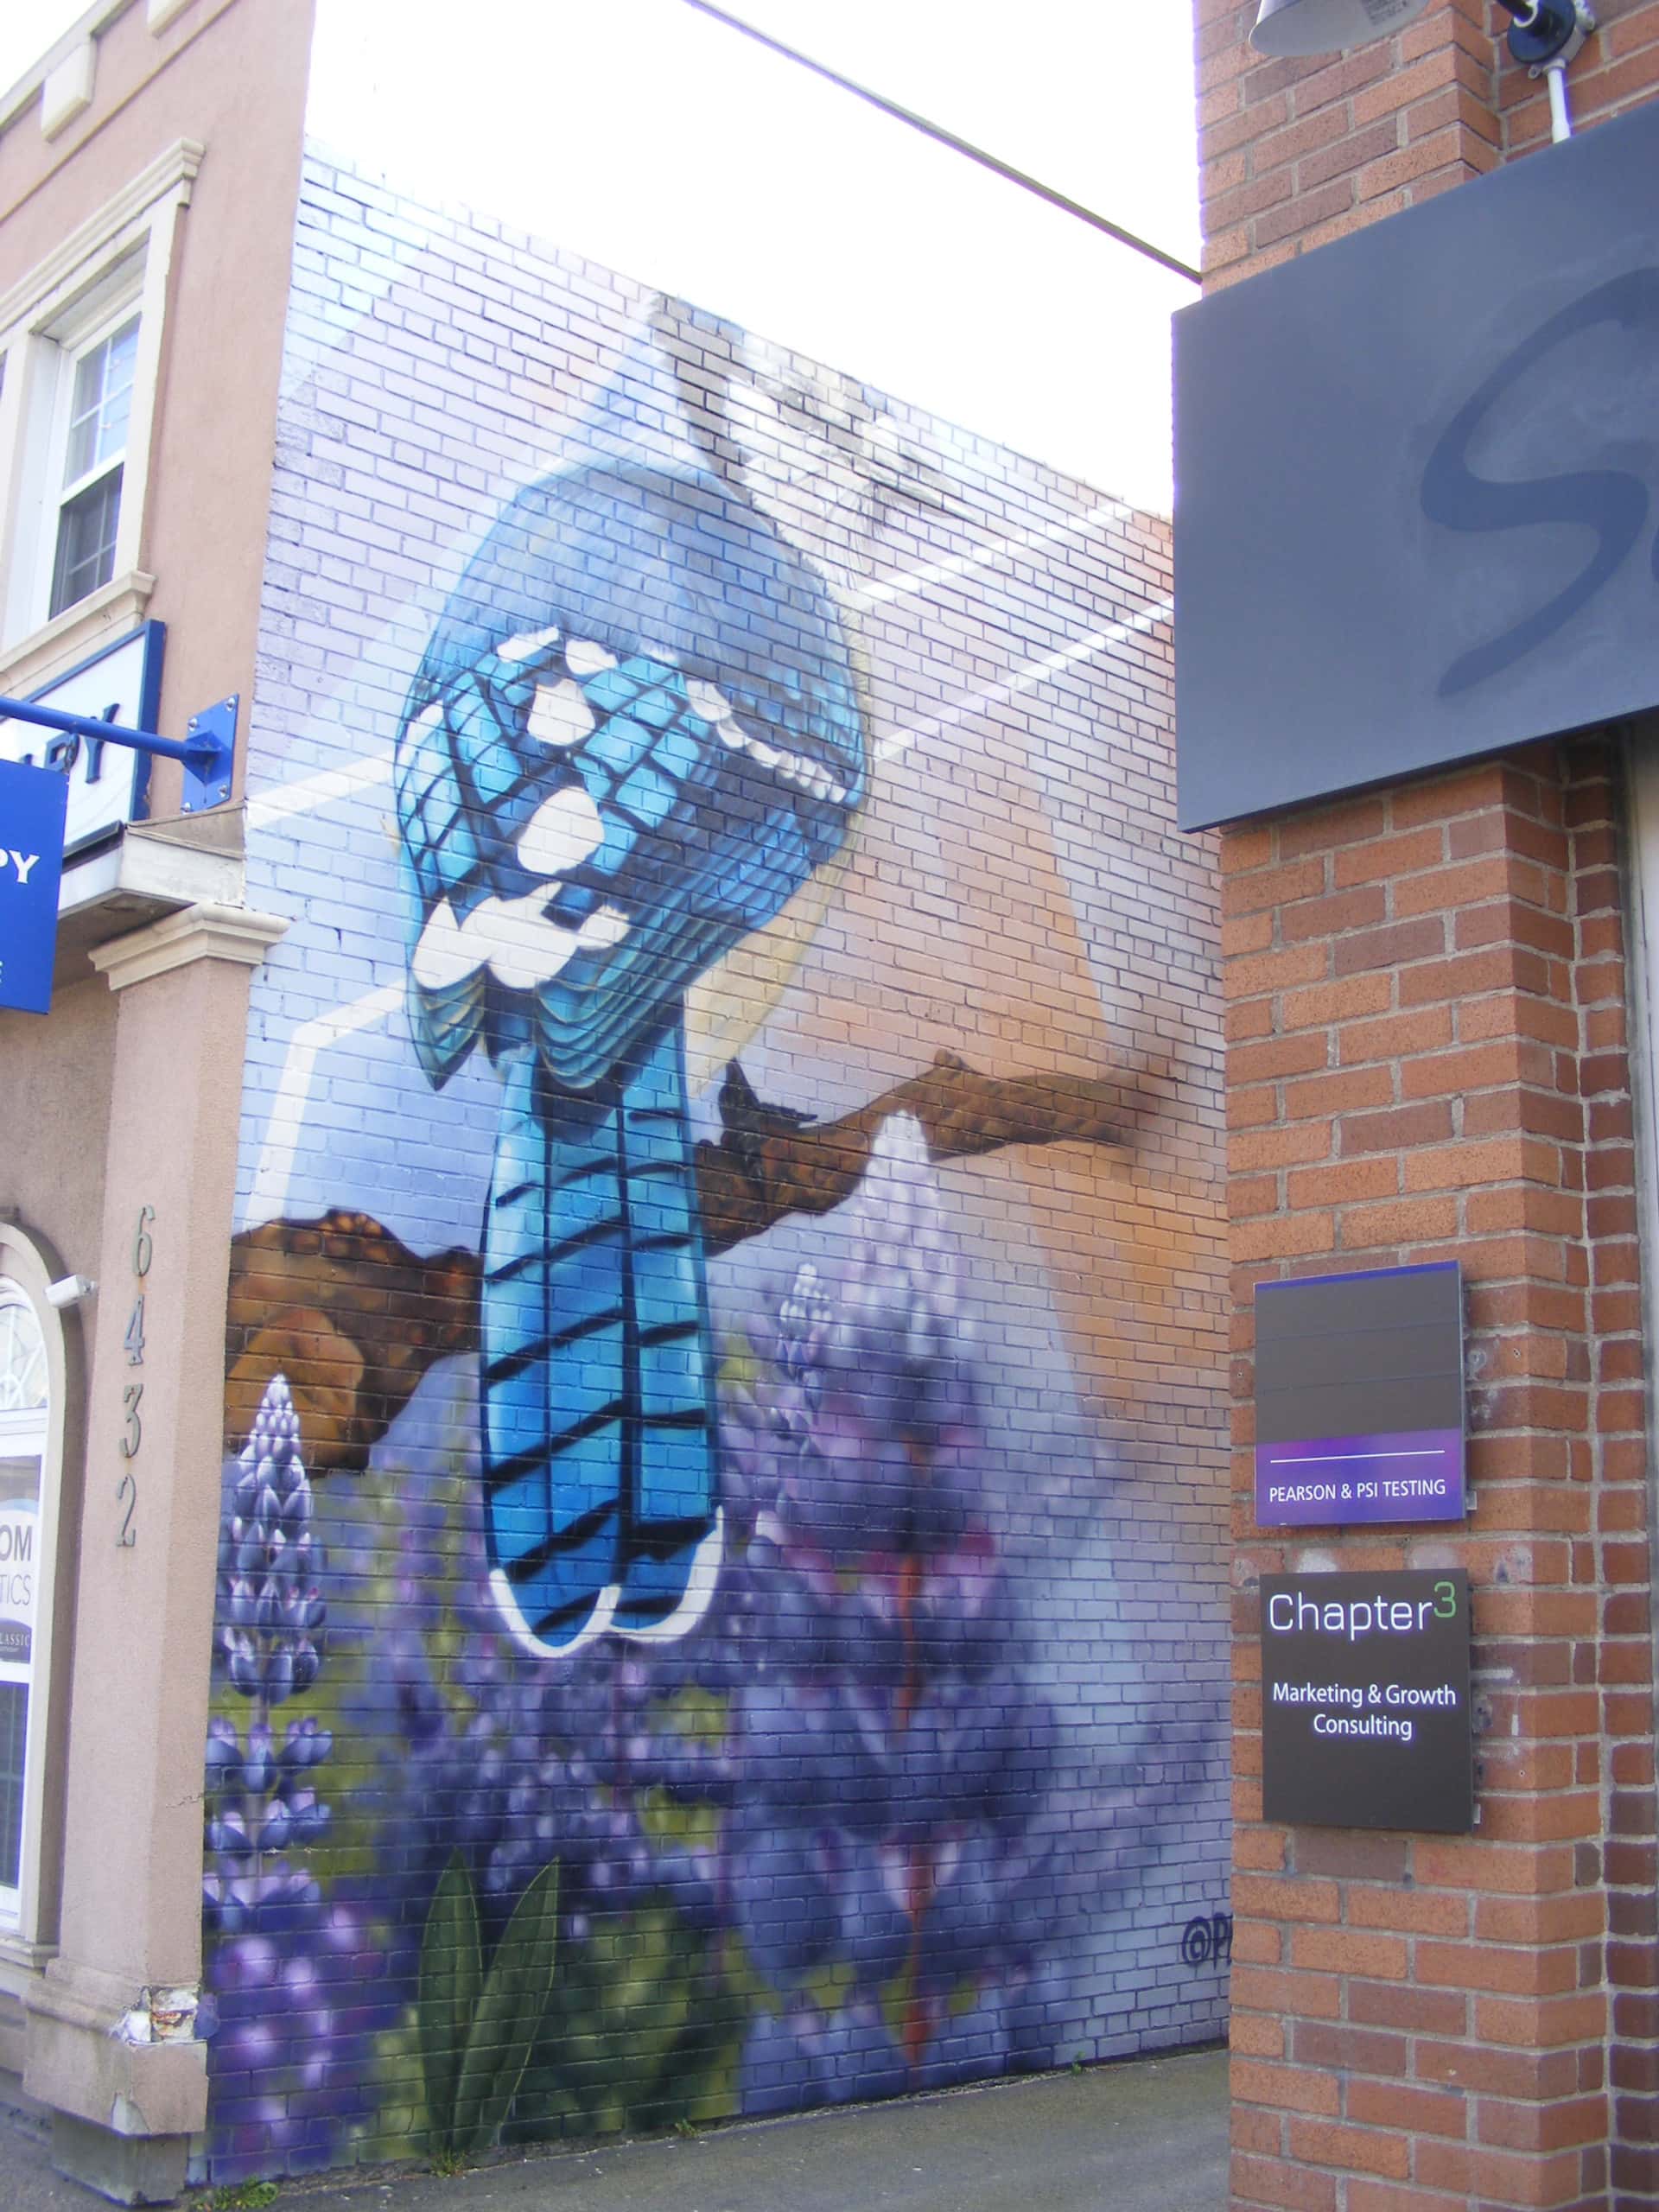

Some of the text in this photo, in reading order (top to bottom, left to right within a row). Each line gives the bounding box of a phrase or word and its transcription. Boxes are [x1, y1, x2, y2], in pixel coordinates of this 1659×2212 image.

[116, 1204, 156, 1548] 6432
[1268, 1478, 1446, 1503] PEARSON & PSI TESTING
[1273, 1681, 1457, 1708] Marketing & Growth
[1313, 1713, 1413, 1741] Consulting
